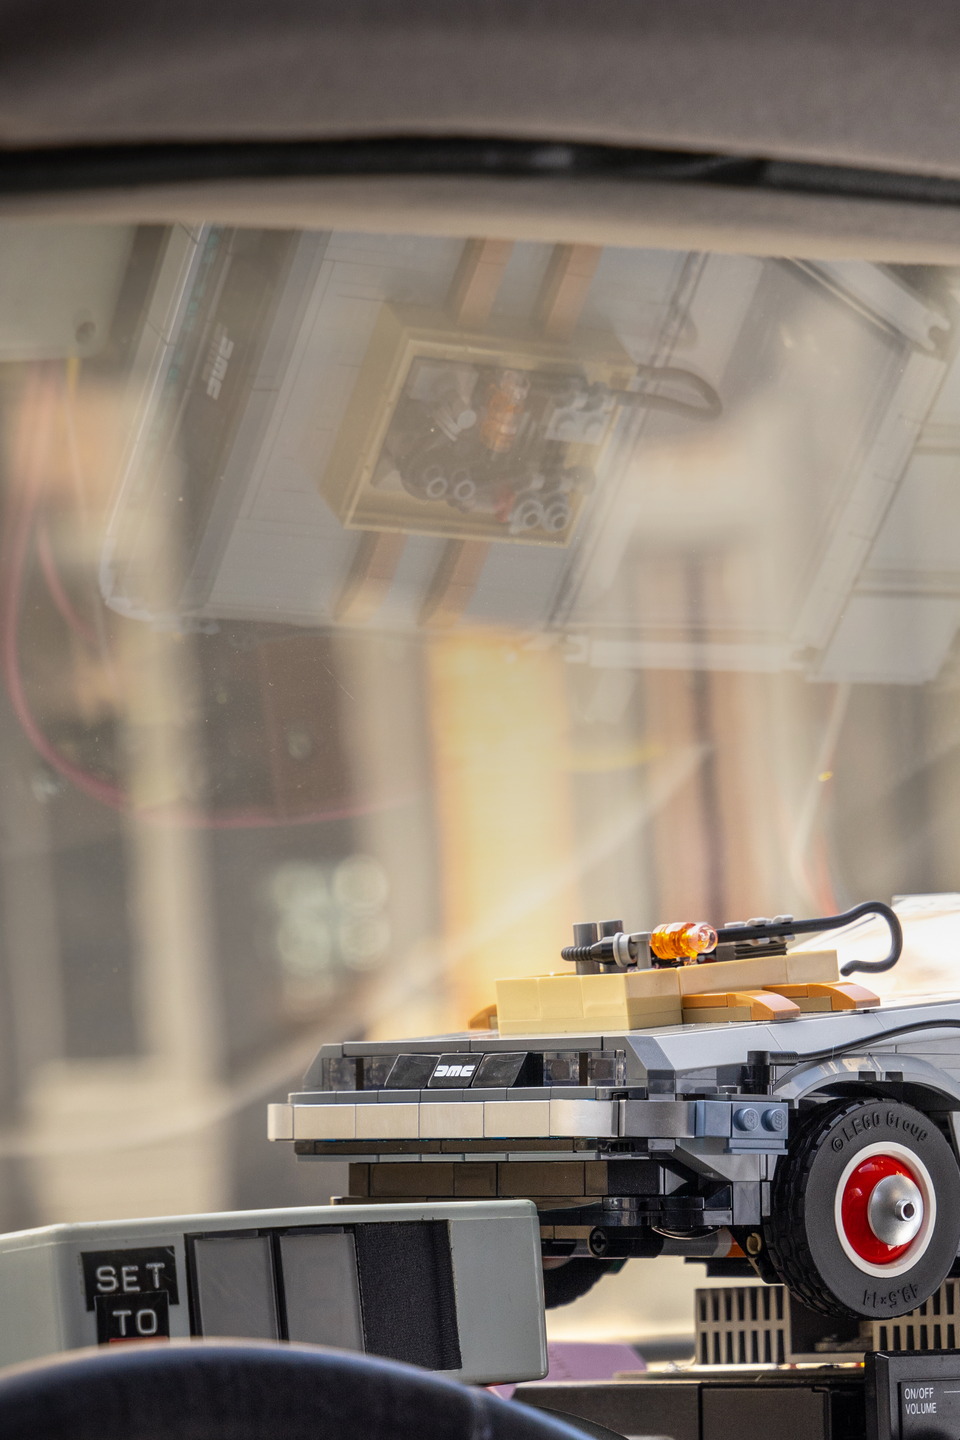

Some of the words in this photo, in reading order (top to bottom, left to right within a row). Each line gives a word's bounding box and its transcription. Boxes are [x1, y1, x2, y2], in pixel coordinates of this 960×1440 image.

[96, 1262, 165, 1293] SET
[113, 1309, 158, 1336] TO
[904, 1387, 934, 1400] ON/OFF
[905, 1403, 937, 1414] VOLUME
